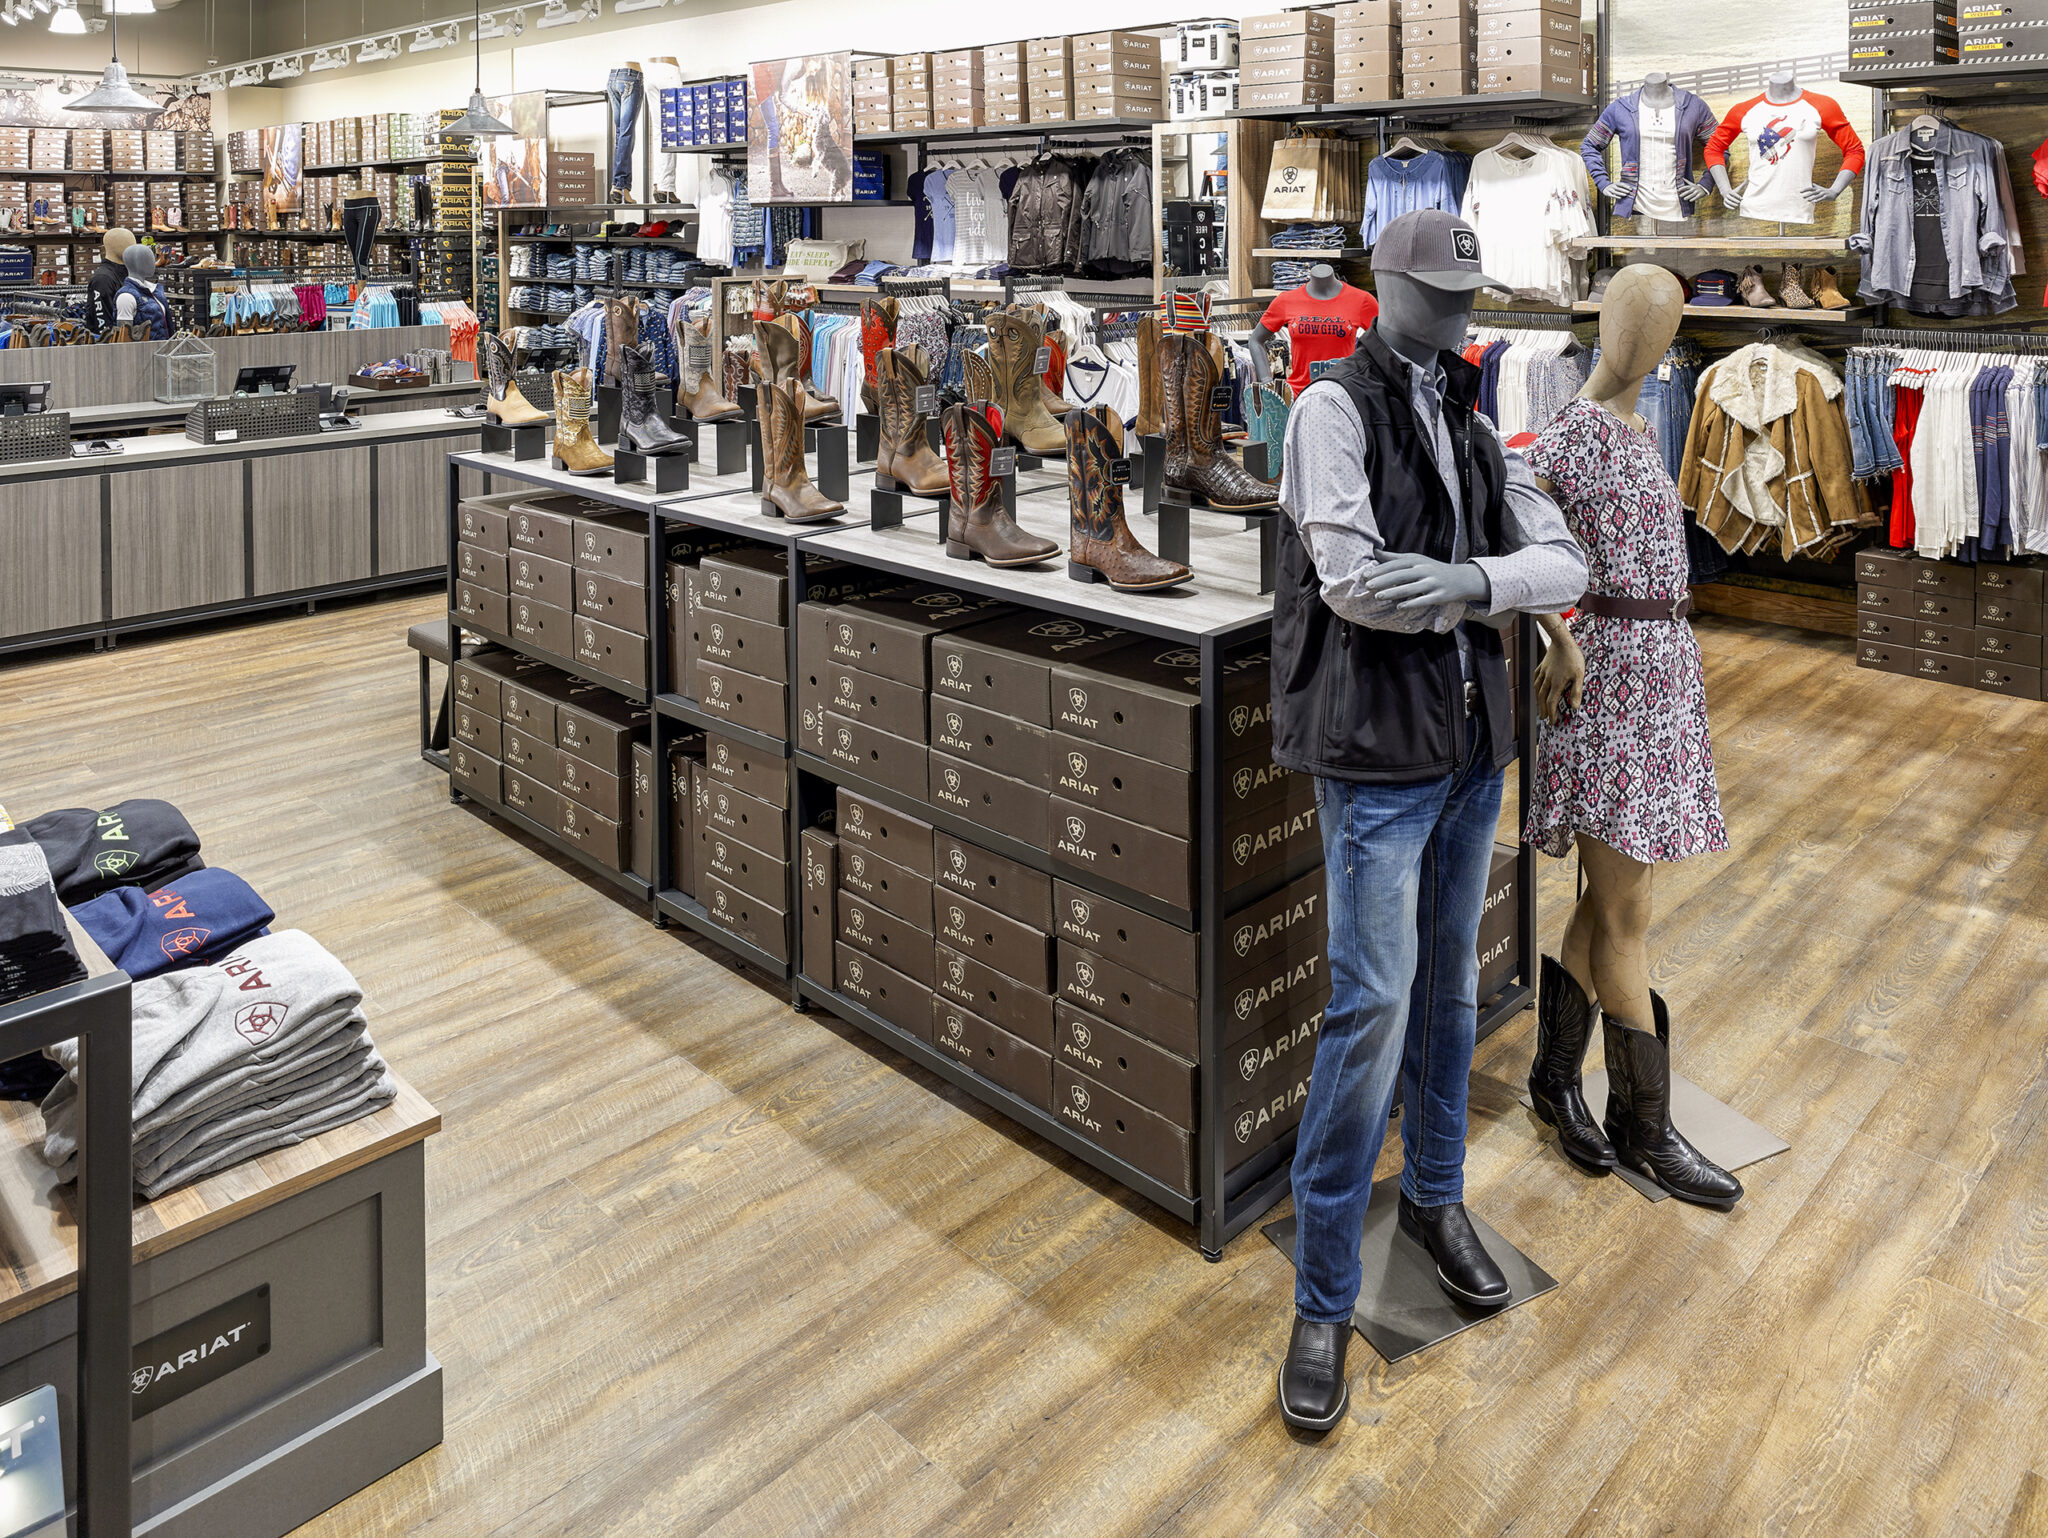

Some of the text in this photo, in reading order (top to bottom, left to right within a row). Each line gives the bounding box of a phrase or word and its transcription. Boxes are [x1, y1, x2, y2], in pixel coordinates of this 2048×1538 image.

[1963, 4, 2002, 13] ARIAT
[1262, 20, 1292, 30] ARIAT
[1852, 14, 1885, 22] ARIAT
[1554, 23, 1572, 32] ARIAT
[1965, 37, 2003, 45] ARIAT
[1262, 45, 1292, 54] ARIAT
[1554, 50, 1571, 58] ARIAT
[1261, 69, 1291, 77] ARIAT
[1260, 93, 1290, 101] ARIAT
[93, 289, 109, 333] ARIA
[1298, 323, 1345, 337] COWGIRL
[462, 530, 477, 538] ARIAT
[516, 534, 535, 544] ARIAT
[580, 552, 601, 563] ARIAT
[462, 568, 477, 577] ARIAT
[516, 580, 534, 590] ARIAT
[1982, 581, 2005, 589] ARIAT
[704, 590, 727, 603] ARIAT
[460, 606, 475, 615] ARIAT
[582, 599, 603, 611] ARIAT
[516, 624, 534, 635] ARIAT
[580, 648, 601, 660] ARIAT
[706, 645, 731, 658] ARIAT
[834, 645, 861, 659] ARIAT
[1981, 646, 2004, 654] ARIAT
[1224, 652, 1271, 675] IAT
[940, 677, 972, 692] ARIAT
[1980, 678, 2003, 686] ARIAT
[457, 689, 473, 700] ARIAT
[705, 697, 730, 711] ARIAT
[834, 696, 861, 712] ARIAT
[506, 710, 522, 723] ARIAT
[1061, 711, 1098, 729] ARIAT
[458, 729, 474, 740] ARIAT
[563, 736, 581, 749] ARIAT
[939, 734, 972, 751] ARIAT
[508, 753, 524, 765] ARIAT
[832, 748, 860, 764] ARIAT
[455, 766, 470, 778] ARIAT
[712, 763, 734, 776] ARIAT
[562, 780, 581, 794] ARIAT
[1060, 776, 1099, 796] ARIAT
[509, 795, 525, 807] ARIAT
[938, 789, 970, 808] ARIAT
[714, 812, 735, 827] ARIAT
[563, 826, 581, 839] ARIAT
[845, 822, 872, 840] ARIAT
[1253, 808, 1315, 855] ARIAT
[1058, 839, 1097, 861] ARIAT
[711, 859, 733, 875] ARIAT
[846, 874, 873, 892] ARIAT
[943, 870, 976, 891] ARIAT
[712, 908, 734, 924] ARIAT
[1253, 894, 1318, 946] ARIAT
[845, 926, 873, 946] ARIAT
[943, 926, 975, 947] ARIAT
[1063, 920, 1100, 942] ARIAT
[843, 979, 871, 999] ARIAT
[1255, 955, 1319, 1009] ARIAT
[942, 980, 975, 1002] ARIAT
[1067, 982, 1105, 1006] ARIAT
[940, 1035, 972, 1057] ARIAT
[1260, 1012, 1322, 1068] ARIAT
[1064, 1044, 1102, 1069] ARIAT
[1062, 1106, 1102, 1132] ARIAT
[155, 1322, 248, 1382] ARIAT
